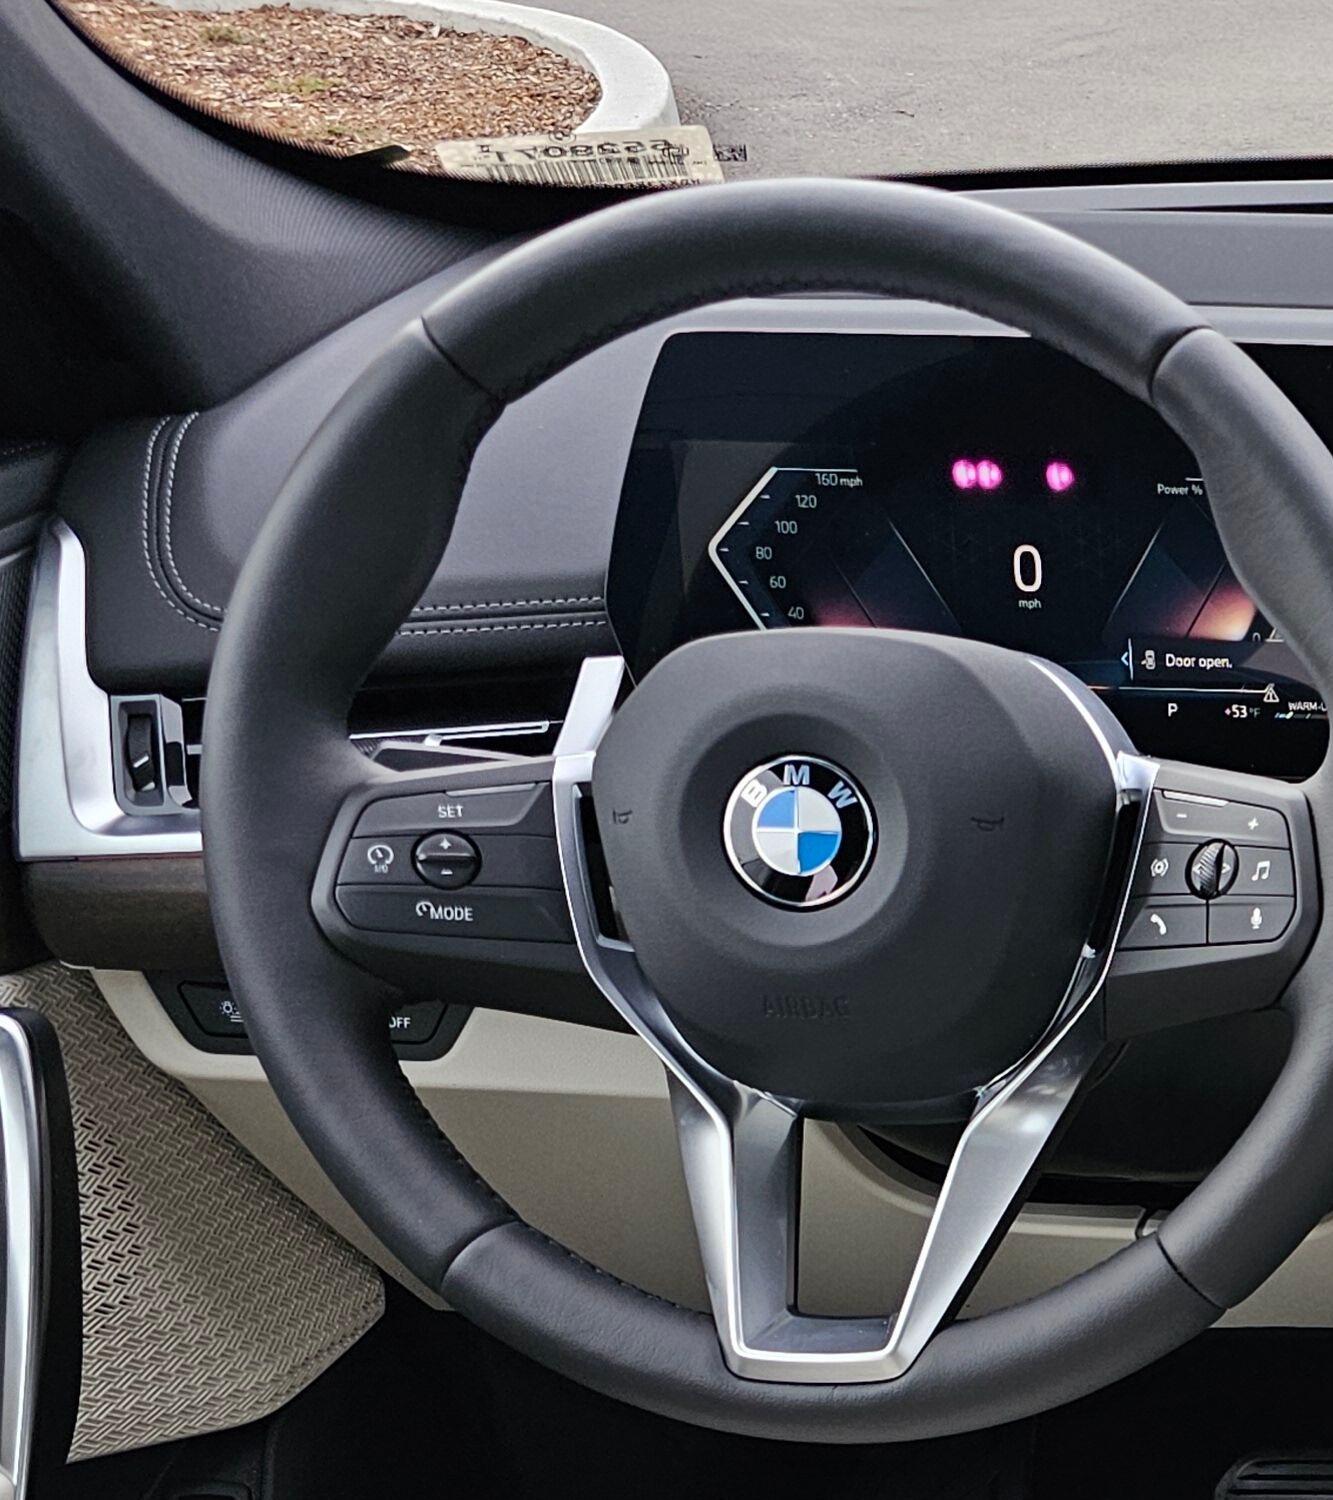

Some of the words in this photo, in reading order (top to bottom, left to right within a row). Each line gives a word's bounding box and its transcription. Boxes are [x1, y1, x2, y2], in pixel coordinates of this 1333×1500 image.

[815, 473, 838, 487] 160
[840, 476, 863, 488] mph
[1157, 483, 1189, 495] Power
[1191, 484, 1203, 495] %
[795, 494, 817, 508] 120
[774, 520, 798, 534] 100
[756, 546, 773, 560] 80
[1013, 544, 1042, 592] 0
[770, 576, 786, 588] 60
[1018, 598, 1042, 610] mph
[788, 606, 804, 620] 40
[1165, 653, 1196, 668] Door
[1198, 657, 1233, 670] open.
[1168, 703, 1178, 717] P
[741, 763, 857, 808] BMW
[438, 804, 464, 818] SET
[430, 906, 474, 922] MODE
